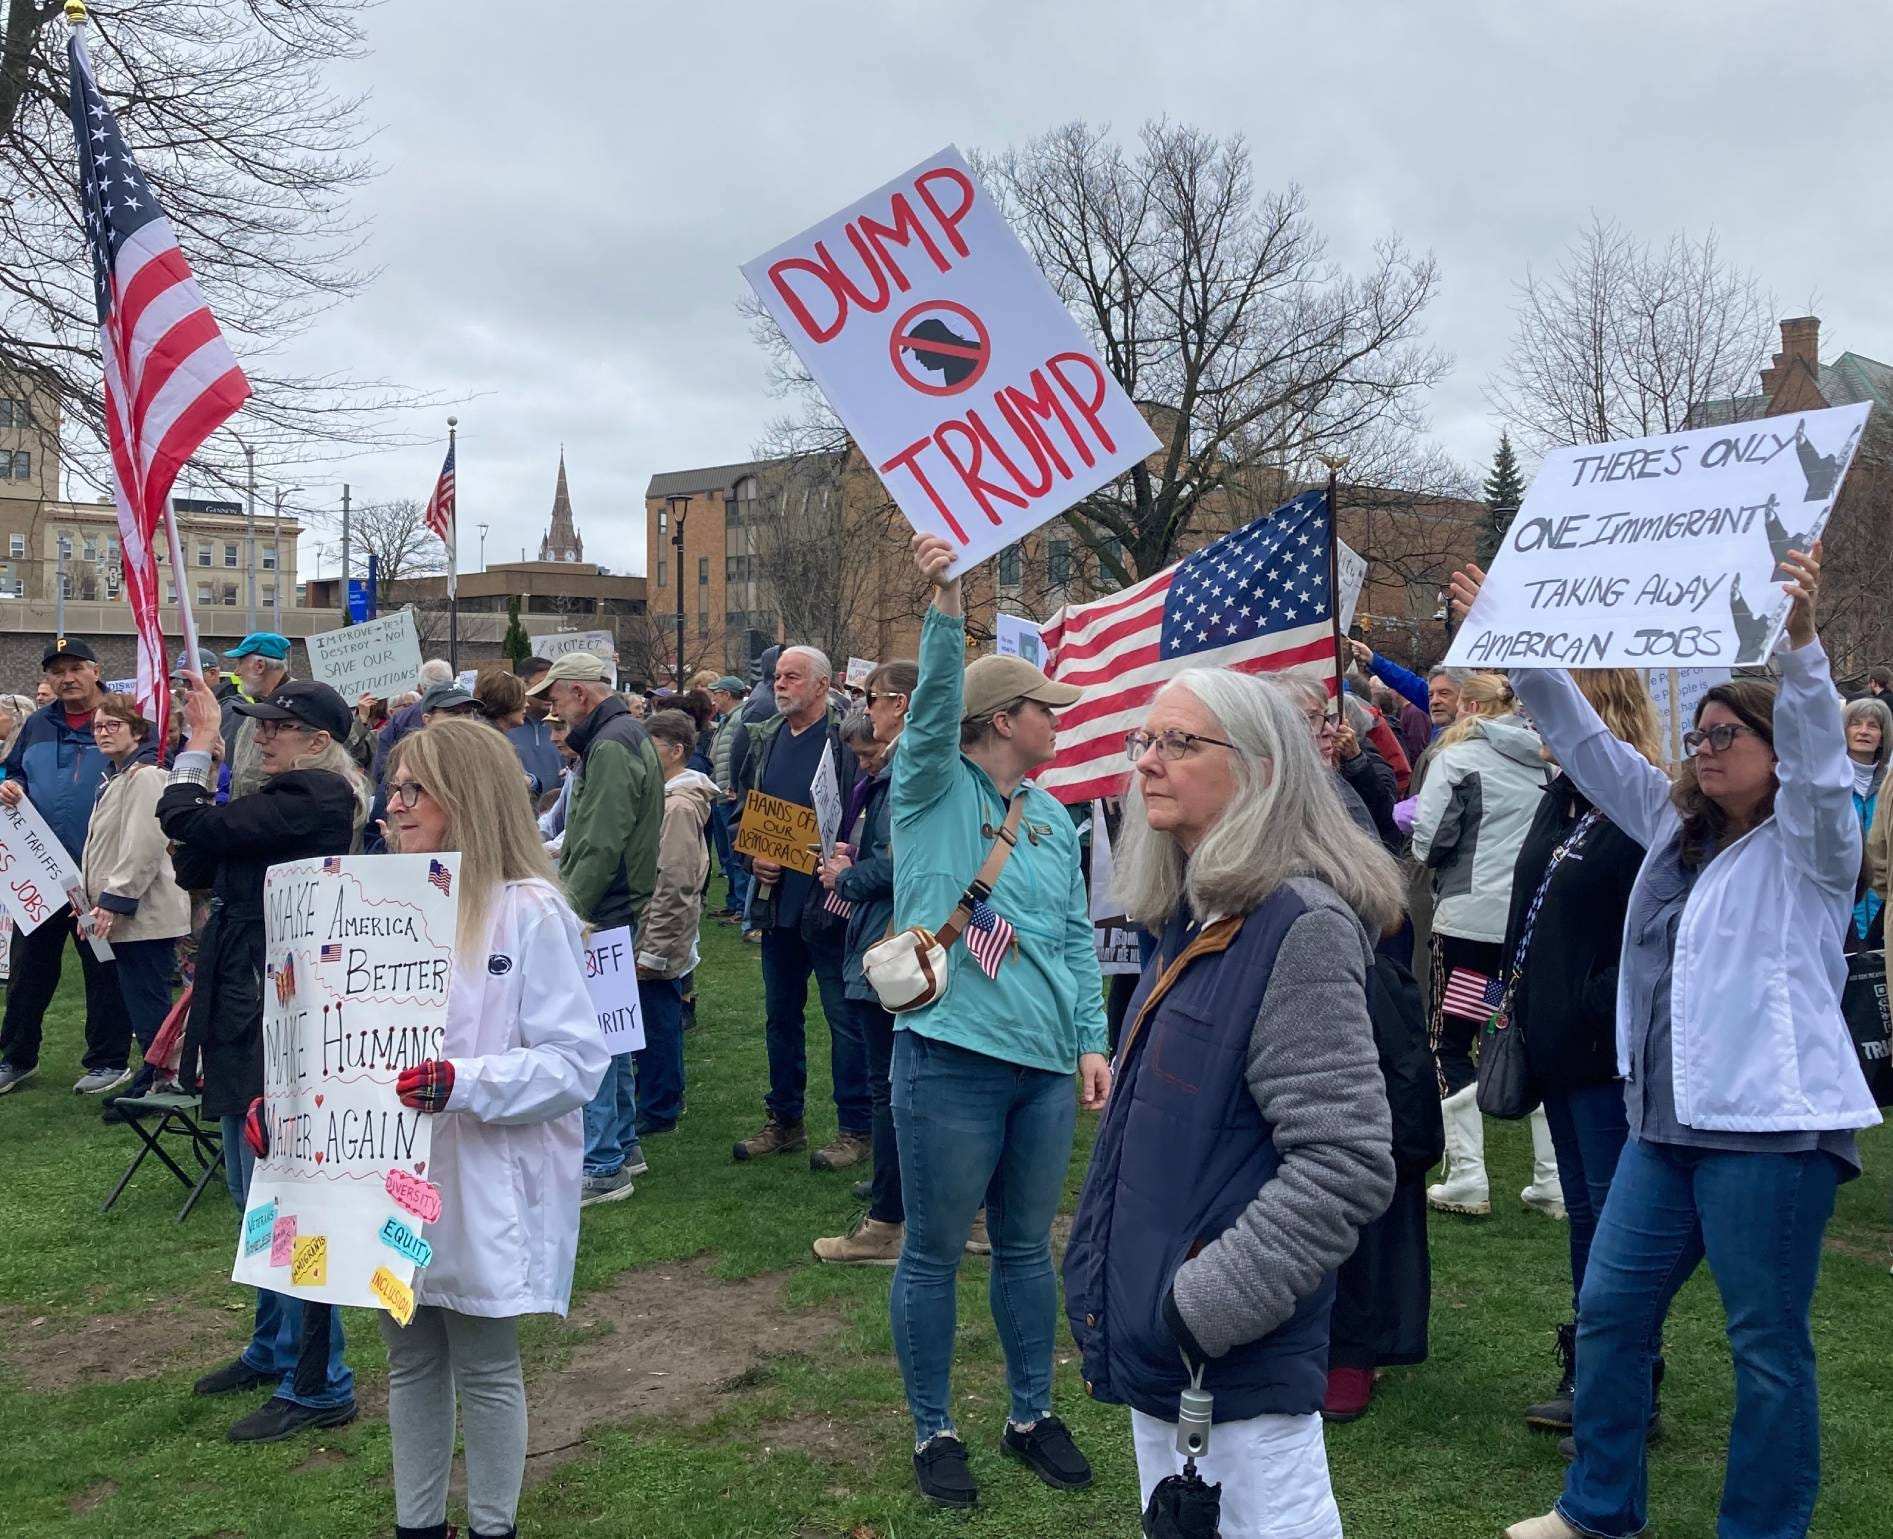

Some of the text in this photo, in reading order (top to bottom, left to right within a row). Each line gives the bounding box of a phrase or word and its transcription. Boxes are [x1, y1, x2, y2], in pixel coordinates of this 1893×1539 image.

[767, 167, 975, 344] DUMP
[879, 352, 1117, 545] TRUMP
[1700, 433, 1797, 469] ONLY
[1514, 513, 1590, 553] ONE
[1524, 572, 1728, 612] TAKING AWAY
[57, 640, 67, 652] P
[316, 627, 374, 648] IMPROVE
[549, 640, 602, 657] PROTECT
[1466, 626, 1723, 664] AMERICAN JOBS
[324, 651, 394, 679] SAVE OUR
[336, 664, 419, 696] NSTITUTIONS!
[748, 792, 793, 822] HANDS
[739, 829, 810, 869] DEMOCRACY
[763, 820, 797, 841] OUR
[24, 830, 63, 881] TARIFFS
[11, 879, 50, 923] JOBS
[269, 881, 419, 944] MAKE AMERICA
[345, 948, 448, 995] BETTER
[266, 1001, 446, 1086] MAKE HUMANS
[266, 1103, 421, 1163] MATTER AGAIN
[385, 1177, 438, 1215] DIVERSITY
[383, 1219, 432, 1267] EQUITY
[372, 1271, 411, 1318] INCLUSION
